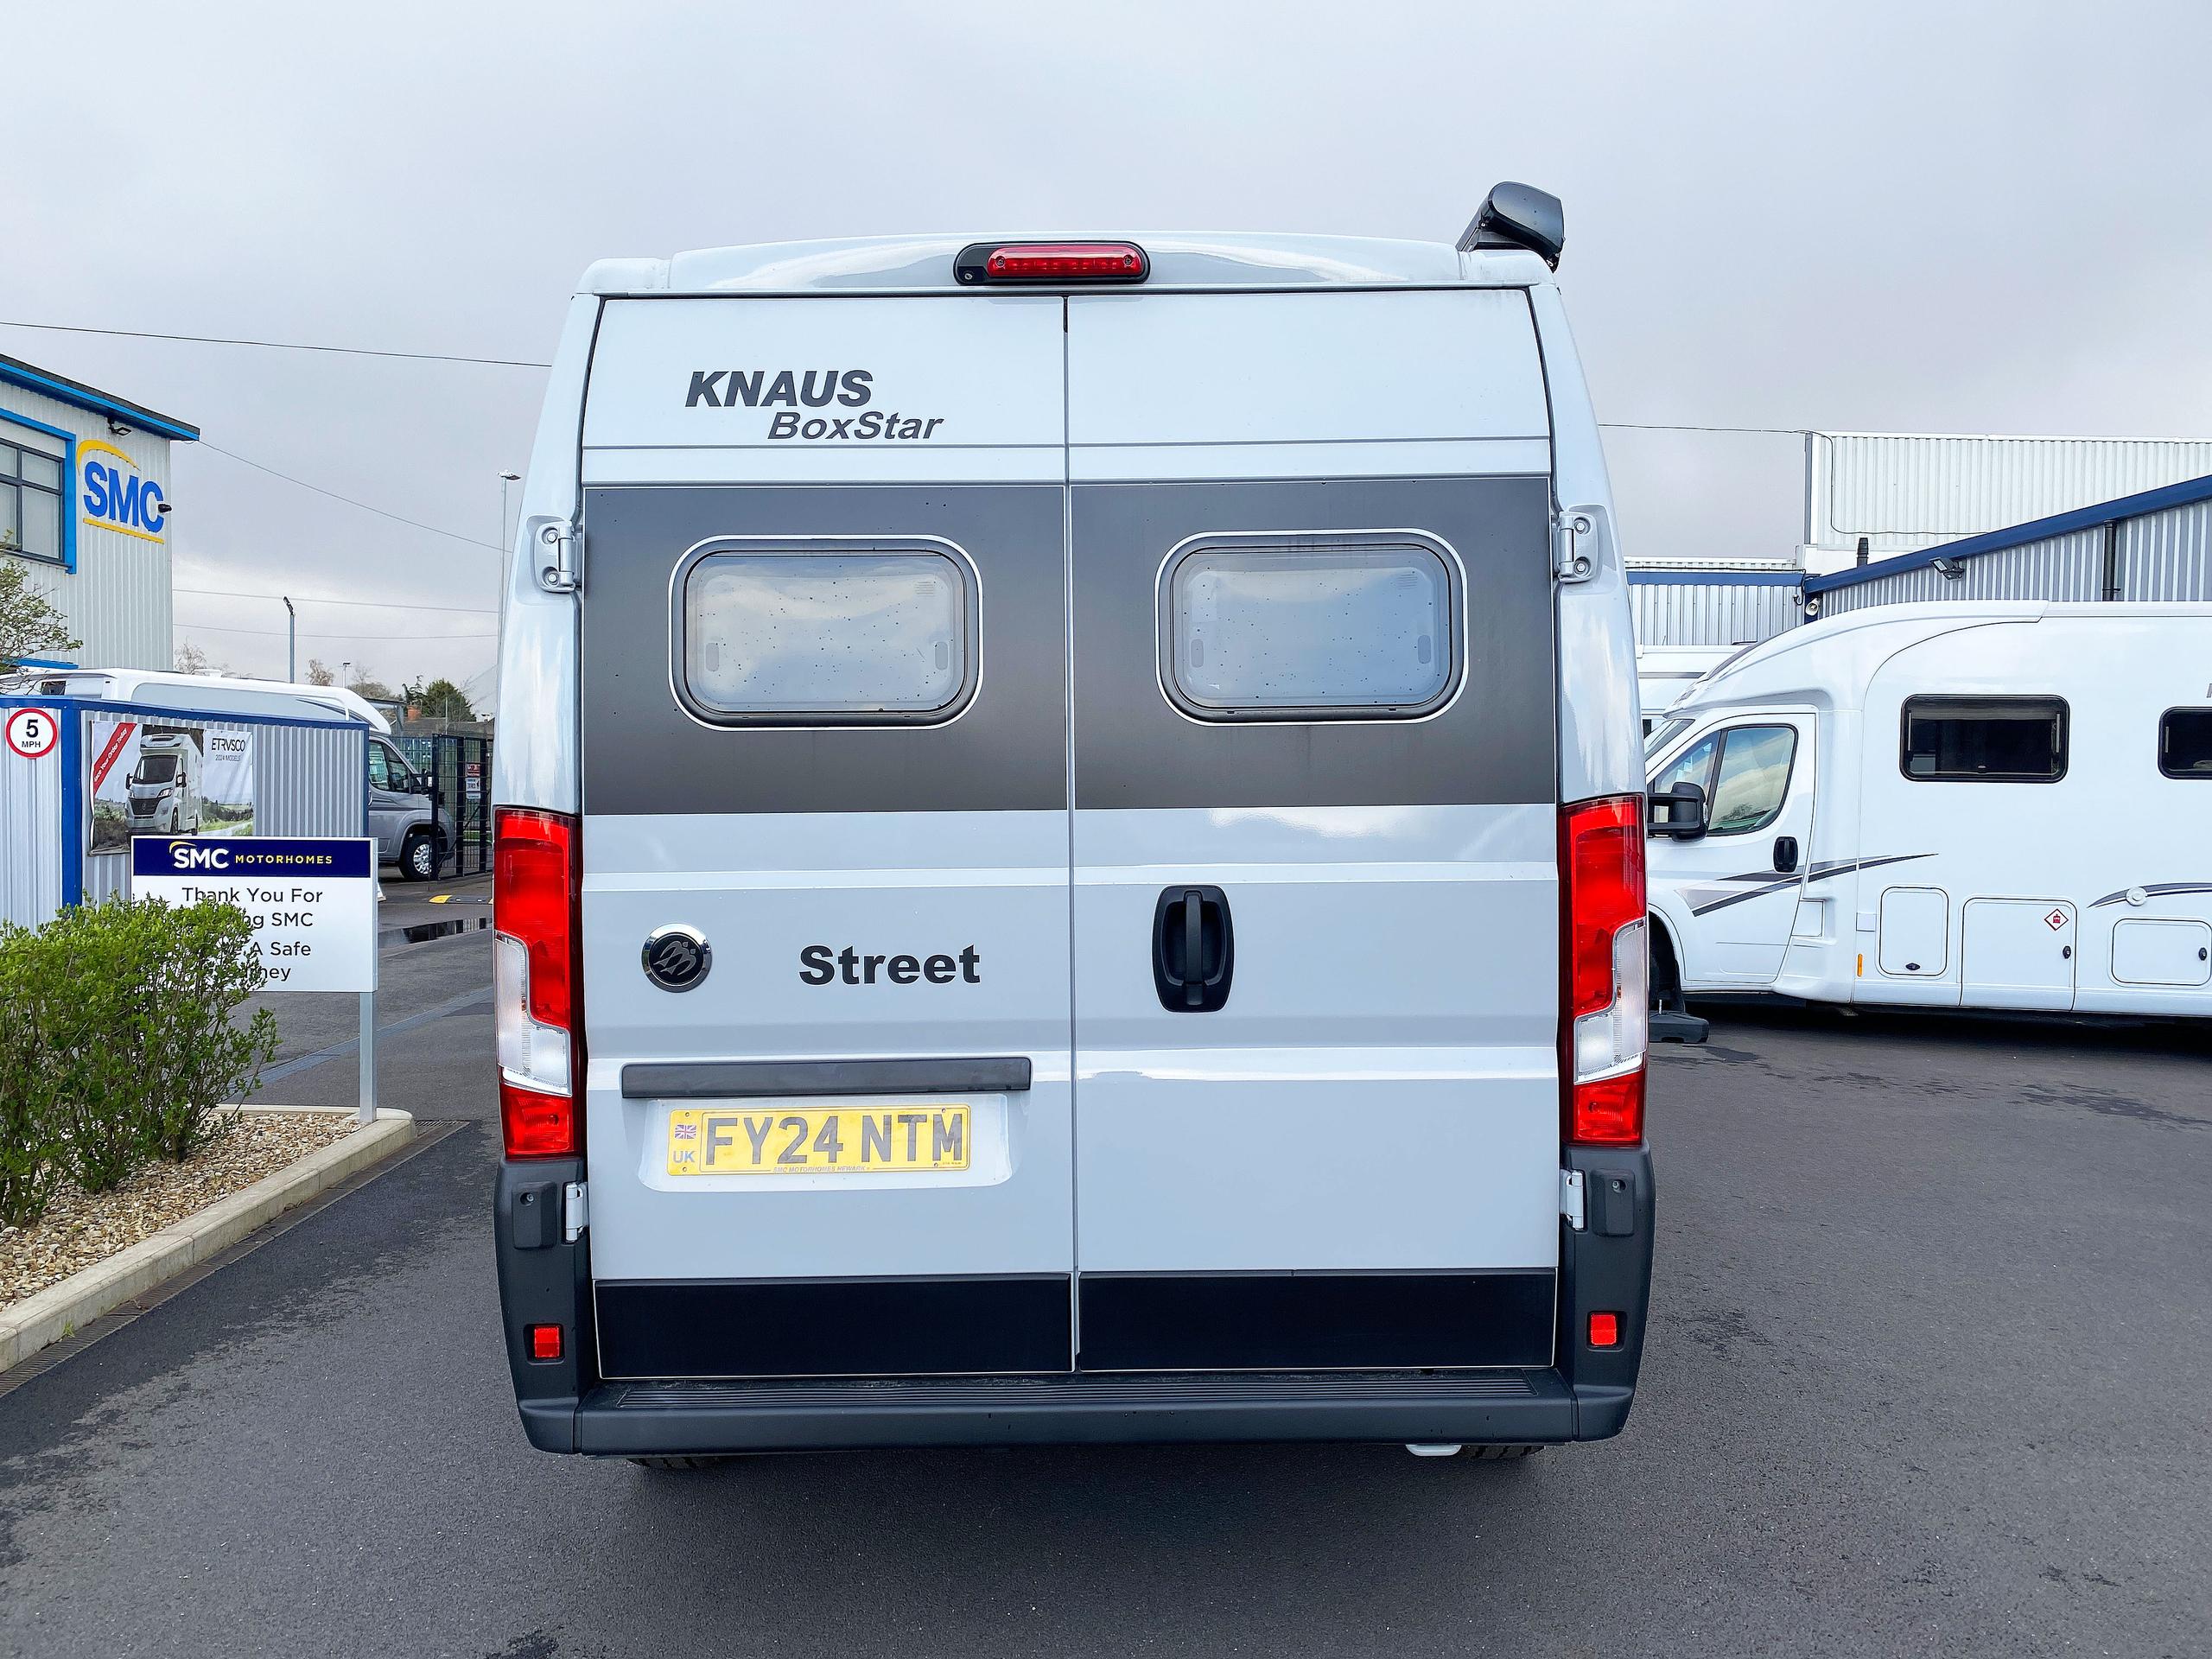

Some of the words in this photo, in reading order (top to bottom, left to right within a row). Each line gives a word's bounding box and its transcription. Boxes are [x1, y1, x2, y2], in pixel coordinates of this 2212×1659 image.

[685, 370, 873, 407] KNAUS
[767, 410, 944, 440] BoxStar
[83, 461, 165, 533] SMC
[25, 719, 39, 739] 5
[173, 849, 229, 869] SMC
[235, 855, 333, 864] MOTORHOMES
[181, 887, 240, 902] Thank
[246, 887, 283, 903] You
[290, 888, 323, 903] For
[270, 912, 314, 927] SMC
[270, 941, 312, 957] Safe
[798, 944, 981, 986] Street
[672, 1150, 696, 1164] UK
[705, 1116, 844, 1166] FY24
[861, 1113, 963, 1163] NTM
